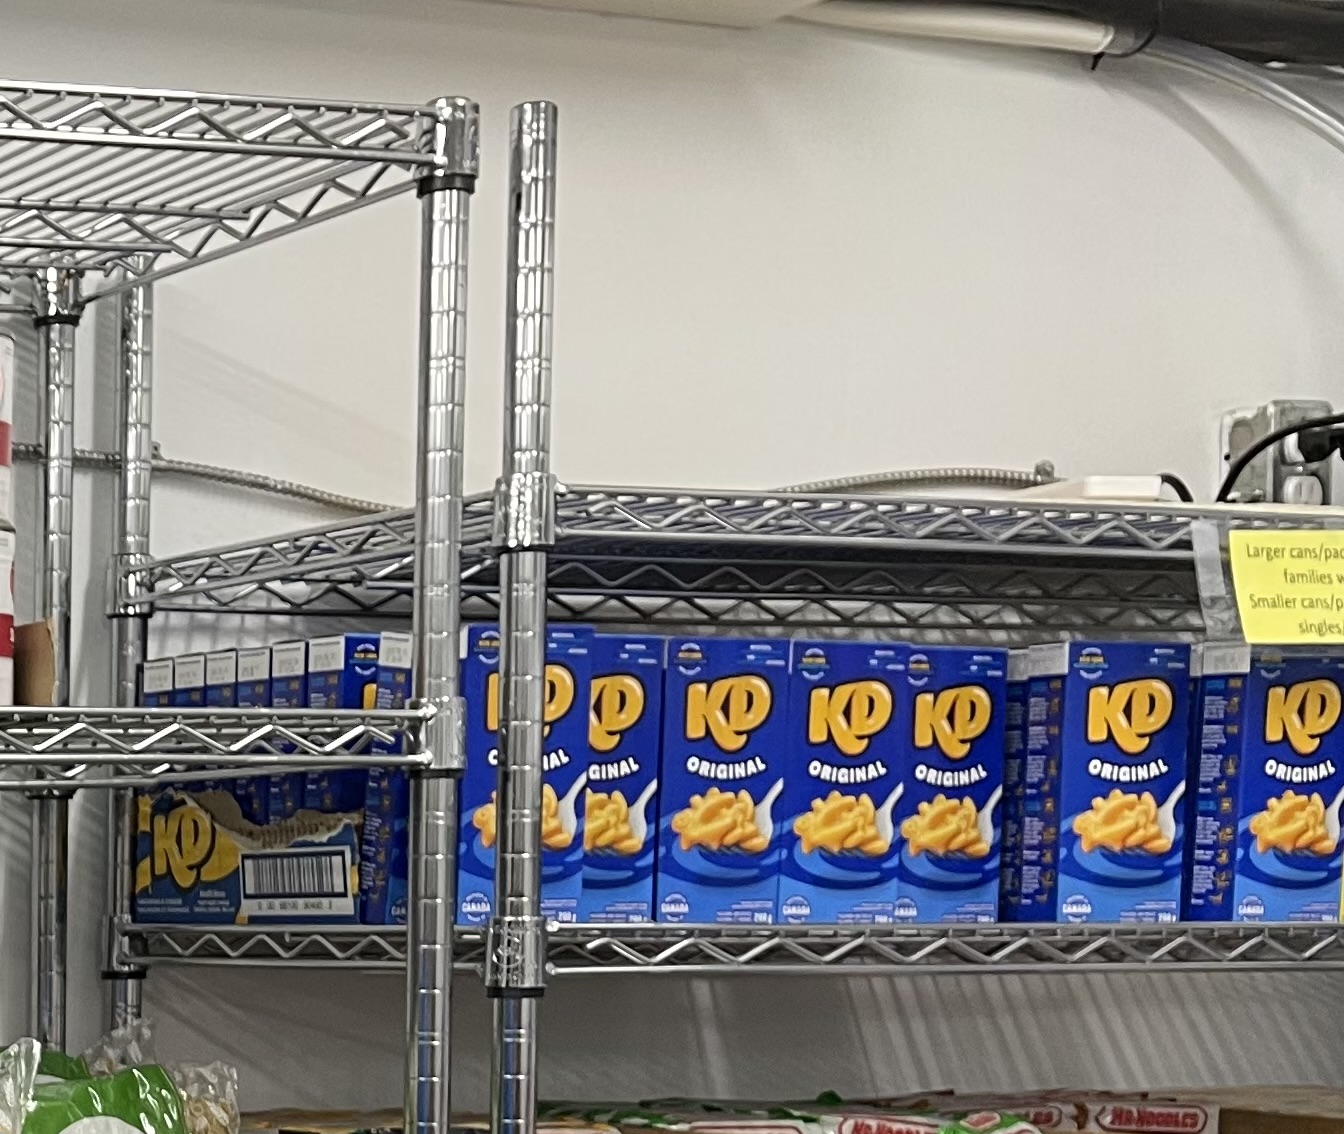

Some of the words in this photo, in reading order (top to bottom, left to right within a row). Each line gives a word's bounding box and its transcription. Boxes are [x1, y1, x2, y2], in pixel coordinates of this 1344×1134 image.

[1246, 544, 1285, 560] Larger
[1284, 568, 1333, 584] families
[1249, 594, 1297, 609] Smaller
[686, 675, 773, 751] KD
[808, 680, 893, 755] KD
[914, 685, 992, 760] KD
[1088, 678, 1173, 754] KD
[1266, 678, 1342, 755] KD
[686, 757, 767, 781] ORIGINAL
[808, 761, 888, 784] ORIGINAL
[915, 764, 988, 787] ORIGINAL
[1088, 759, 1169, 782] ORIGINAL
[1265, 759, 1336, 783] ORIGINAL
[153, 805, 215, 889] KD
